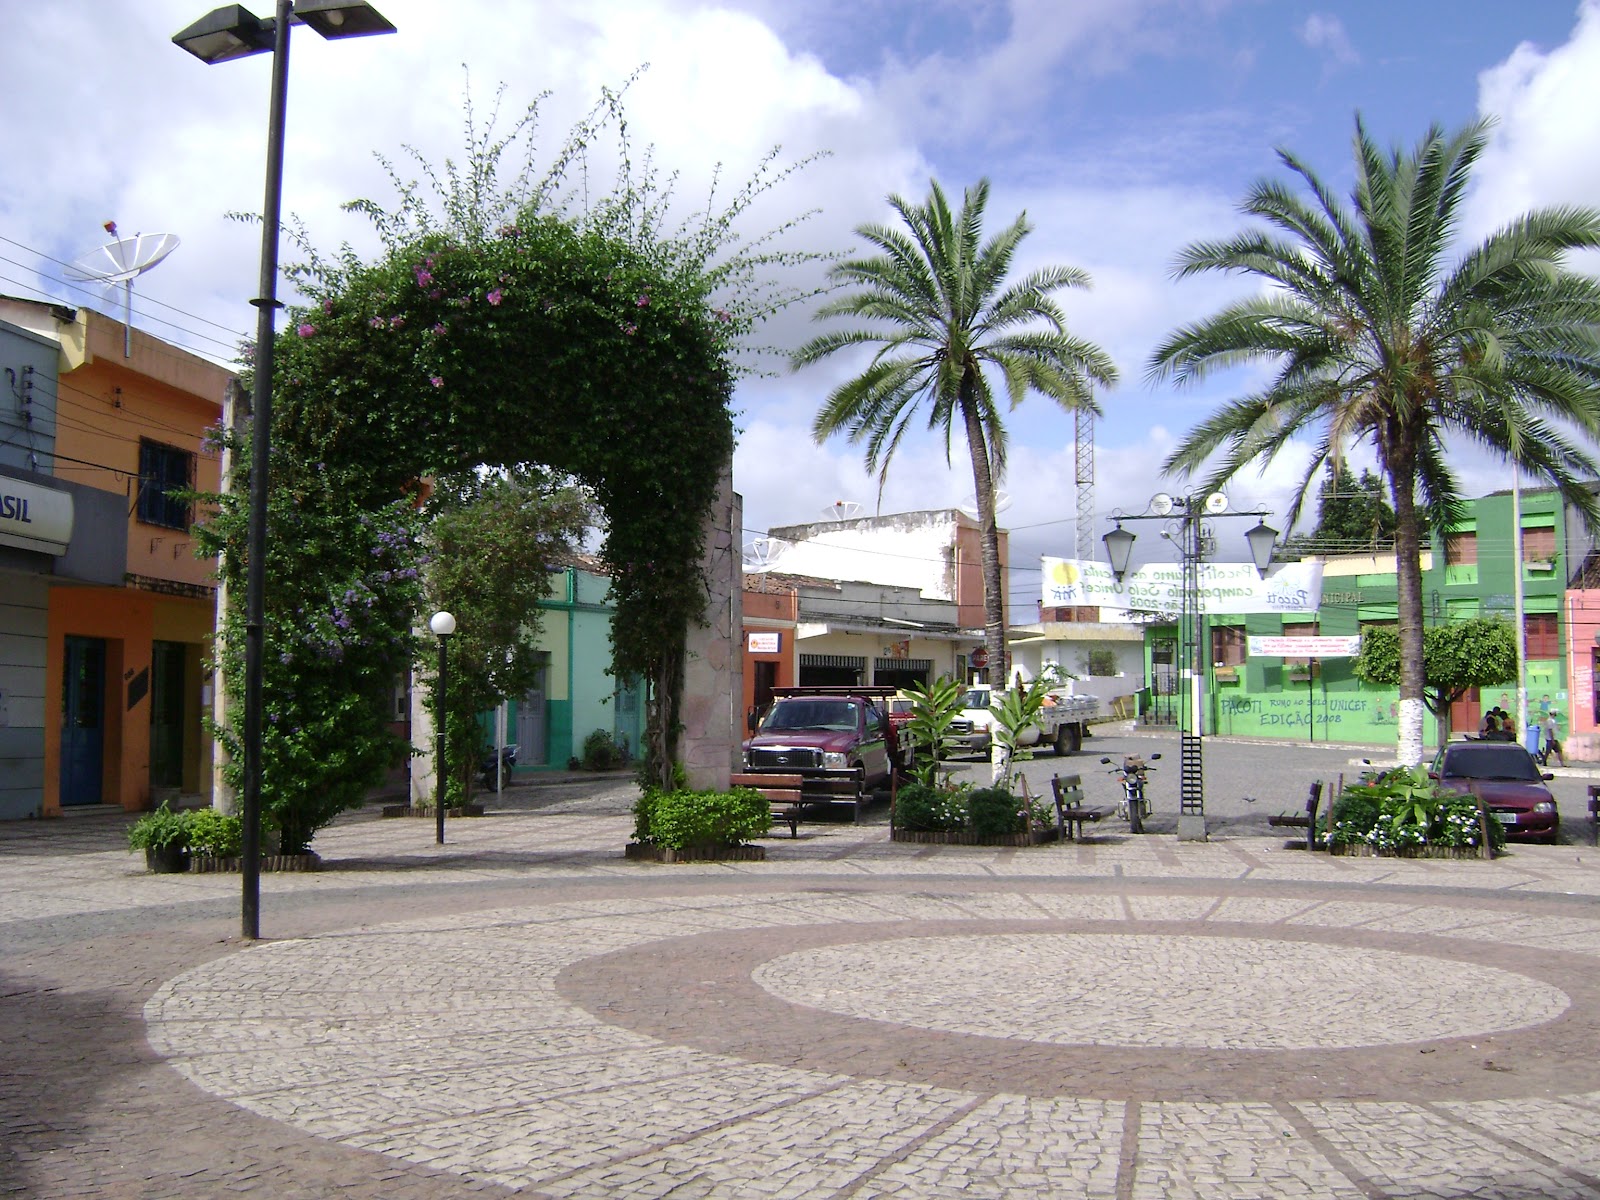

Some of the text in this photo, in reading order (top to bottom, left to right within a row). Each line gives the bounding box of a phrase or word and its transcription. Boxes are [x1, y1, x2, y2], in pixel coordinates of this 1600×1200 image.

[972, 654, 988, 662] PARE
[1220, 699, 1262, 715] PACOTI
[1269, 699, 1292, 708] RUMO
[1329, 699, 1367, 711] UNICEF
[1260, 711, 1342, 727] EDIÇÃO 2008
